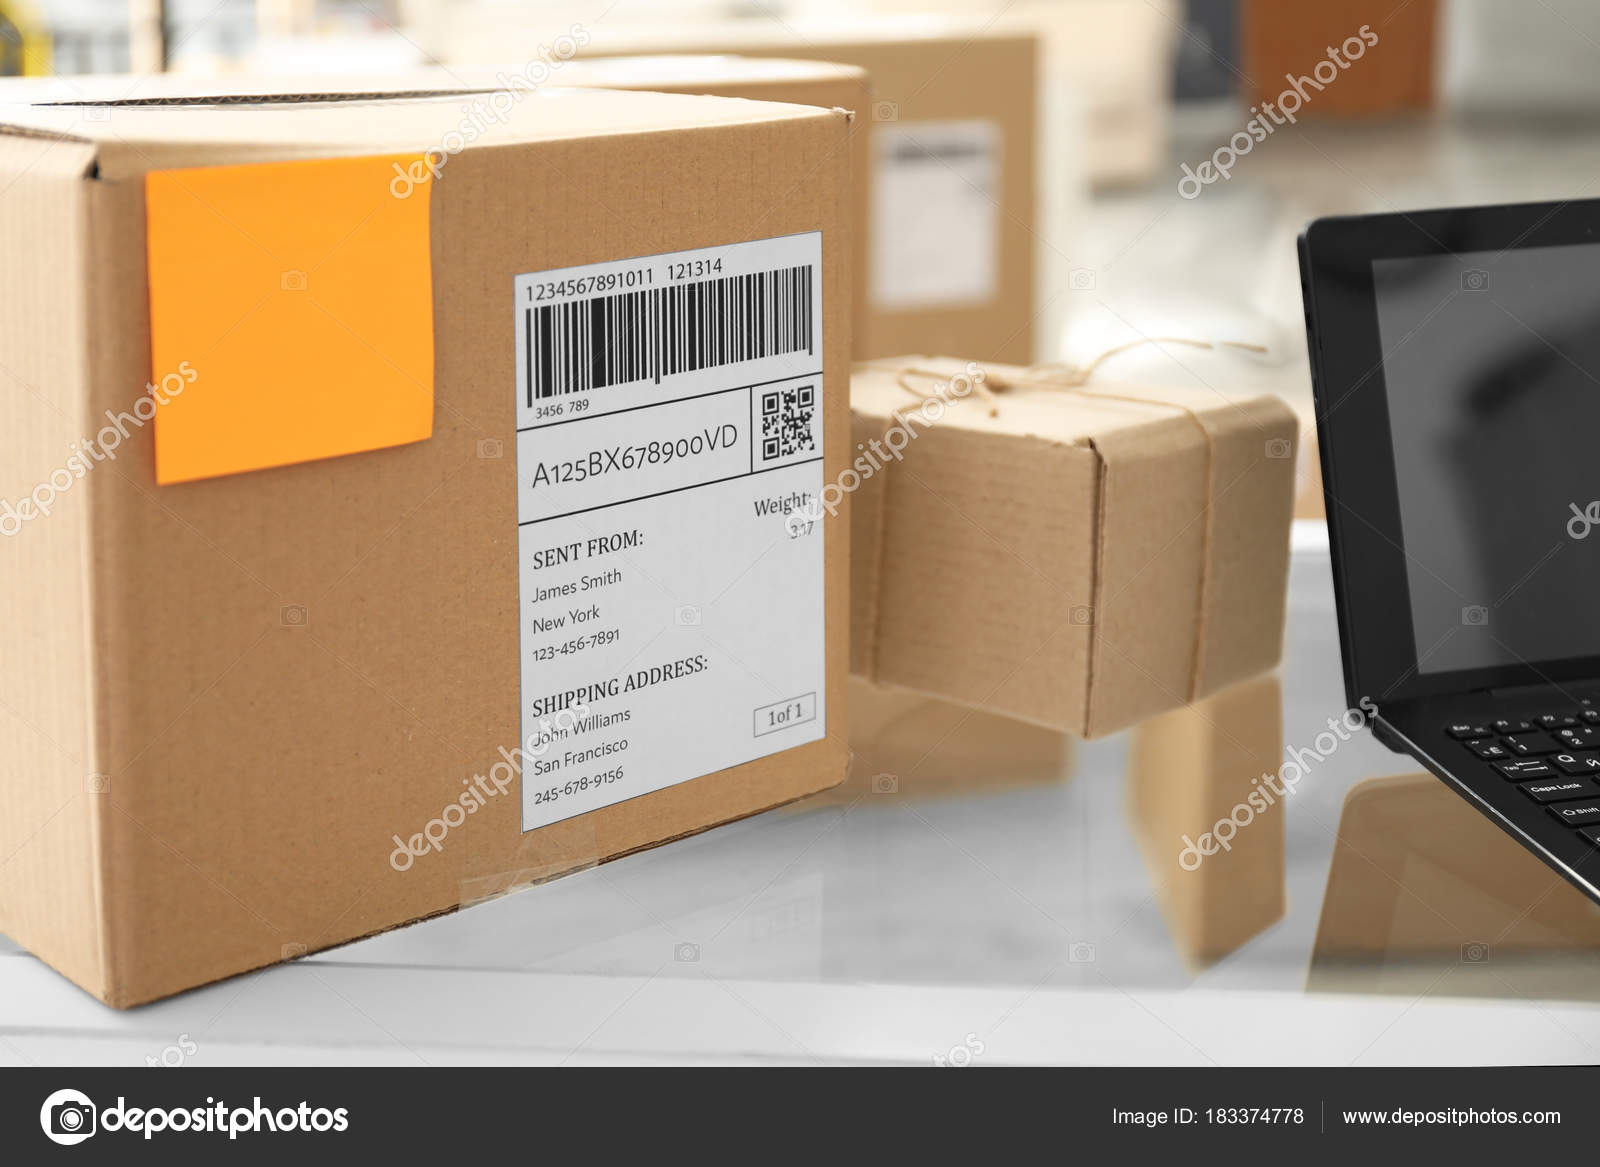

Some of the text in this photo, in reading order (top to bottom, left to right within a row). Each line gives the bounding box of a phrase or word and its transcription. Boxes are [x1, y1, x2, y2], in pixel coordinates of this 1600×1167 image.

[526, 258, 722, 302] 1234567891011 121314
[535, 399, 589, 419] 3456 789
[532, 424, 737, 488] A125BX678900VD
[754, 491, 811, 516] Weight:
[533, 530, 644, 570] SENT FROM:
[532, 569, 622, 603] James Smith
[533, 604, 600, 634] New York
[532, 629, 620, 662] 123-456-7891
[532, 655, 708, 718] SHIPPING ADDRESS:
[534, 709, 631, 747] John Williams
[534, 739, 628, 776] San Francisco
[1557, 754, 1577, 763] Q
[535, 766, 624, 805] 245-678-9156
[1530, 784, 1557, 793] Caps
